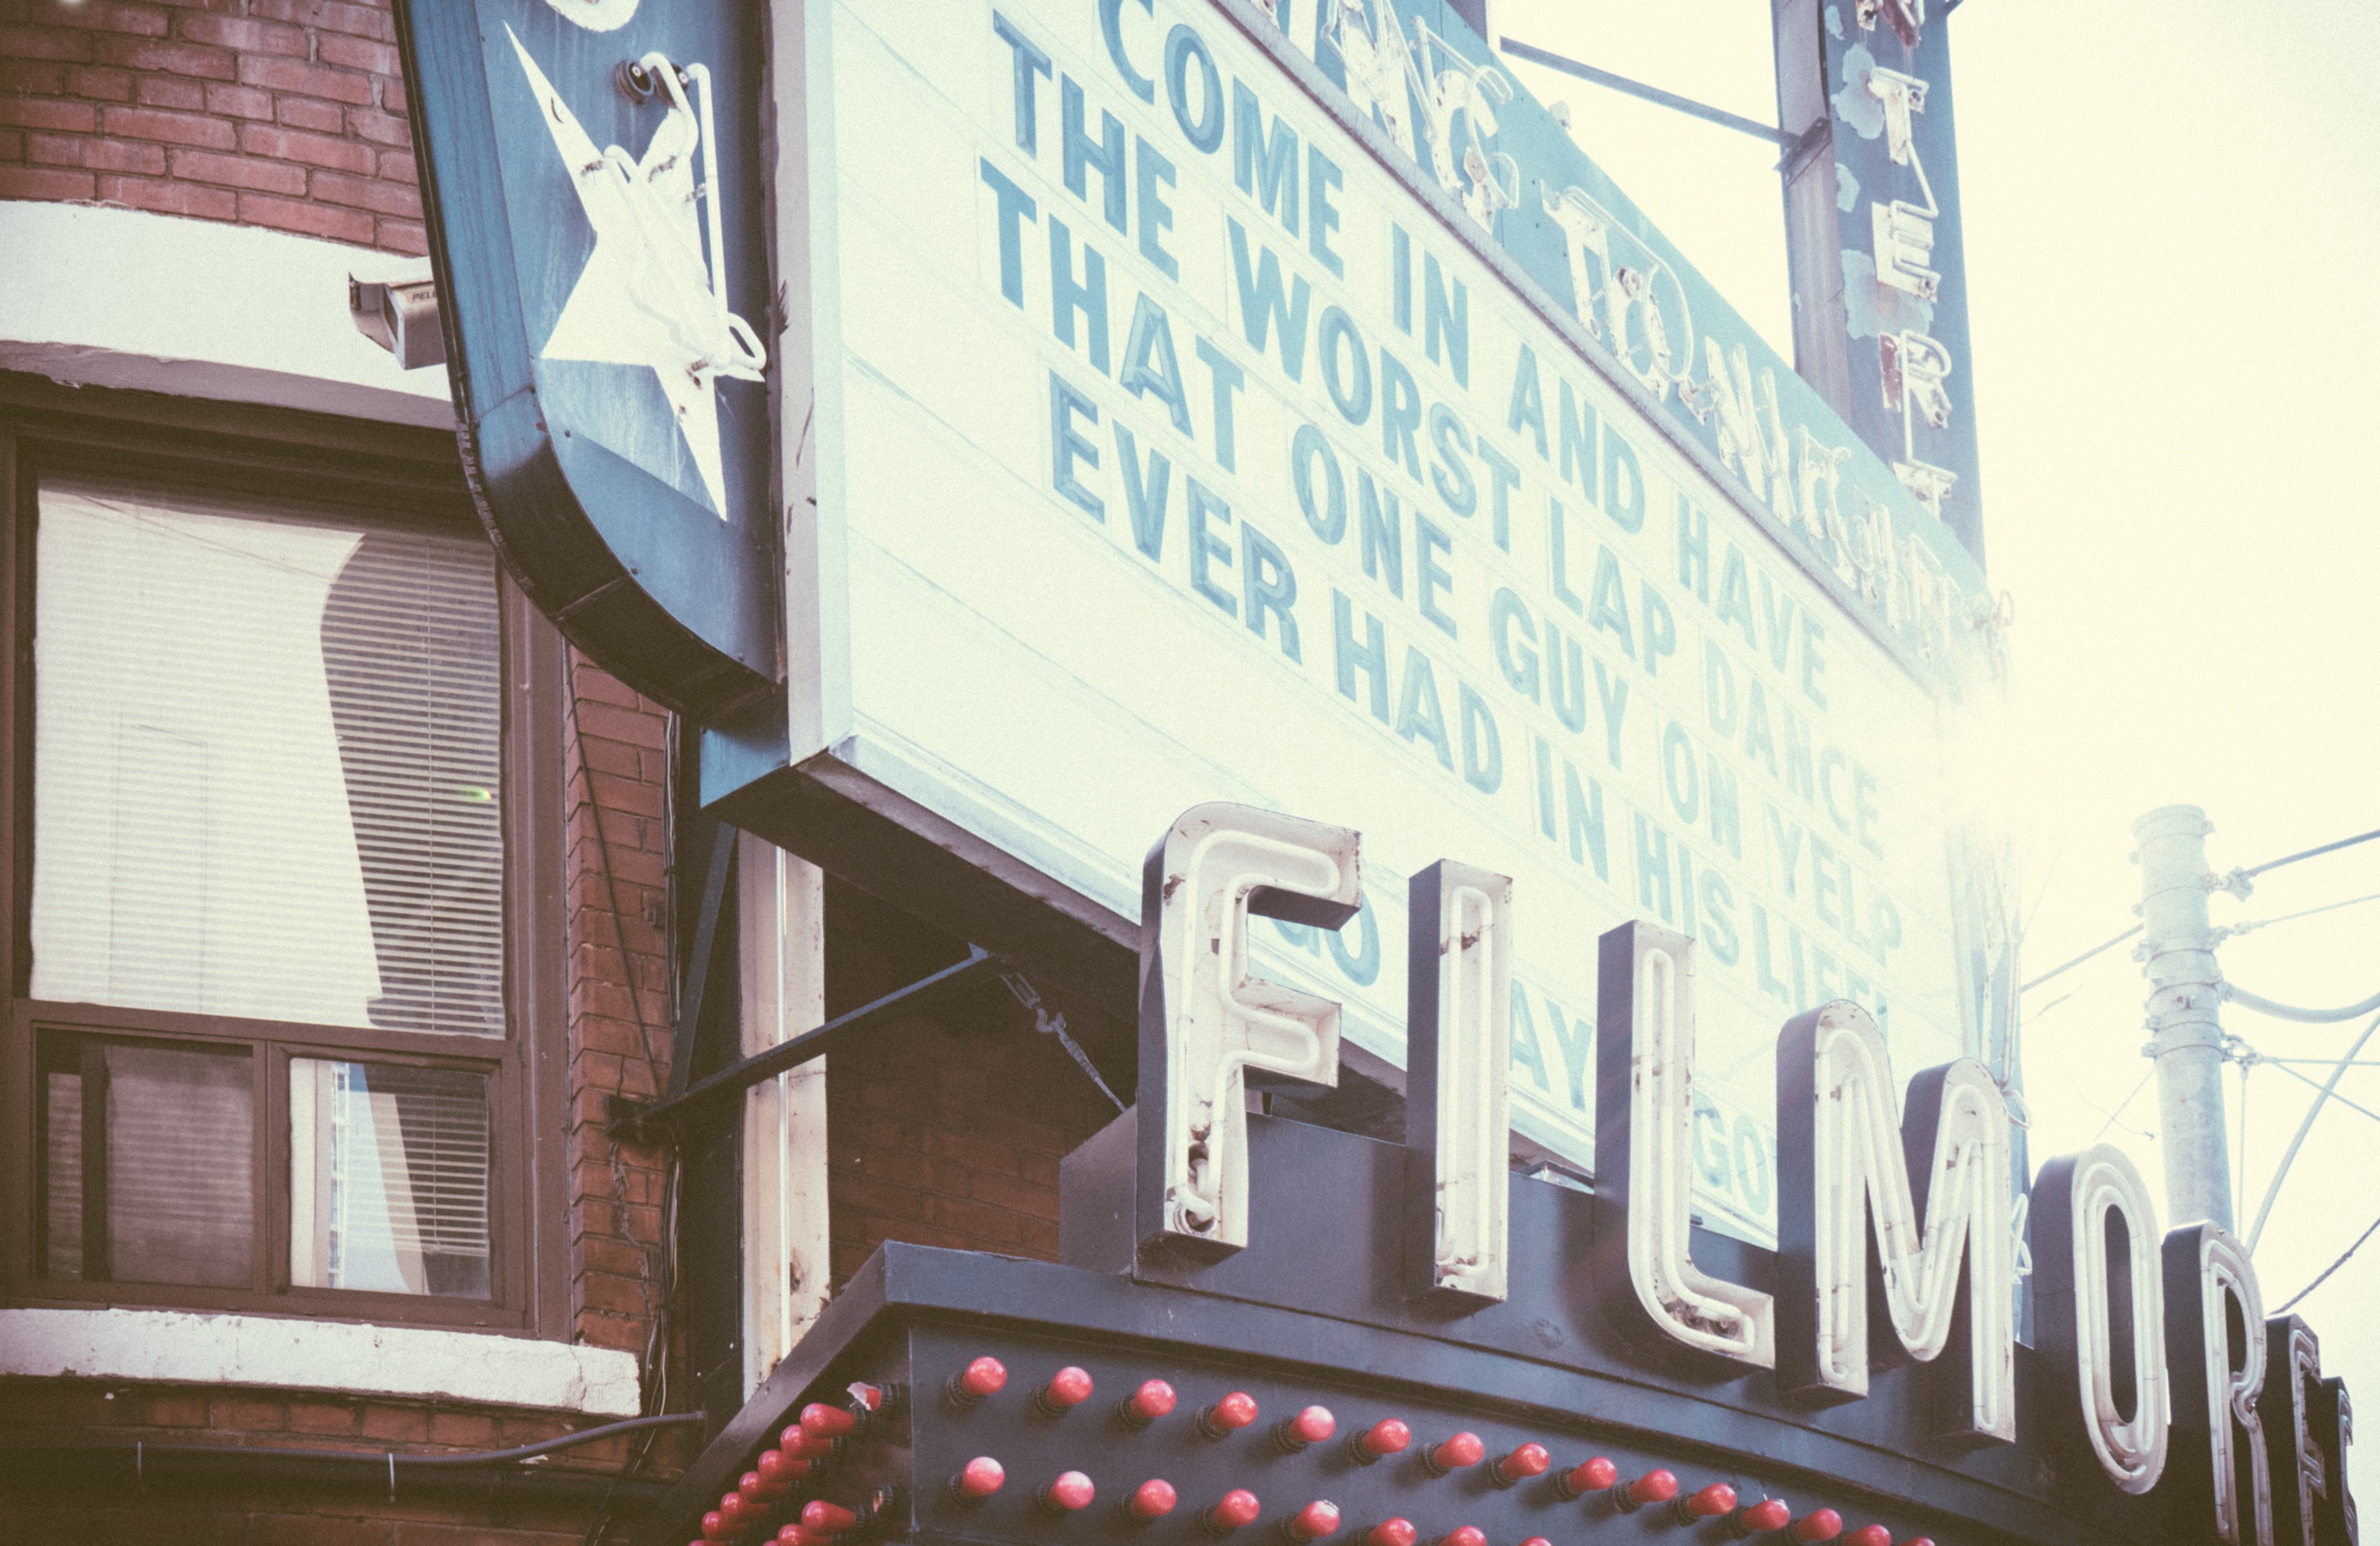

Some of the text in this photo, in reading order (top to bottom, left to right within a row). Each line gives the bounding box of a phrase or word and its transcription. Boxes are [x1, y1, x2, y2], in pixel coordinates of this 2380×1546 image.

[980, 156, 1902, 967] THAT ONE GUY ON YELP
[993, 9, 1883, 860] THE WORST LAP DANCE
[1049, 368, 1302, 666] EVER
[1333, 586, 1503, 795] HAD
[1535, 735, 1609, 884] IN
[1634, 809, 1740, 966] HIS
[1098, 0, 1827, 712] COME IN AND HAVE
